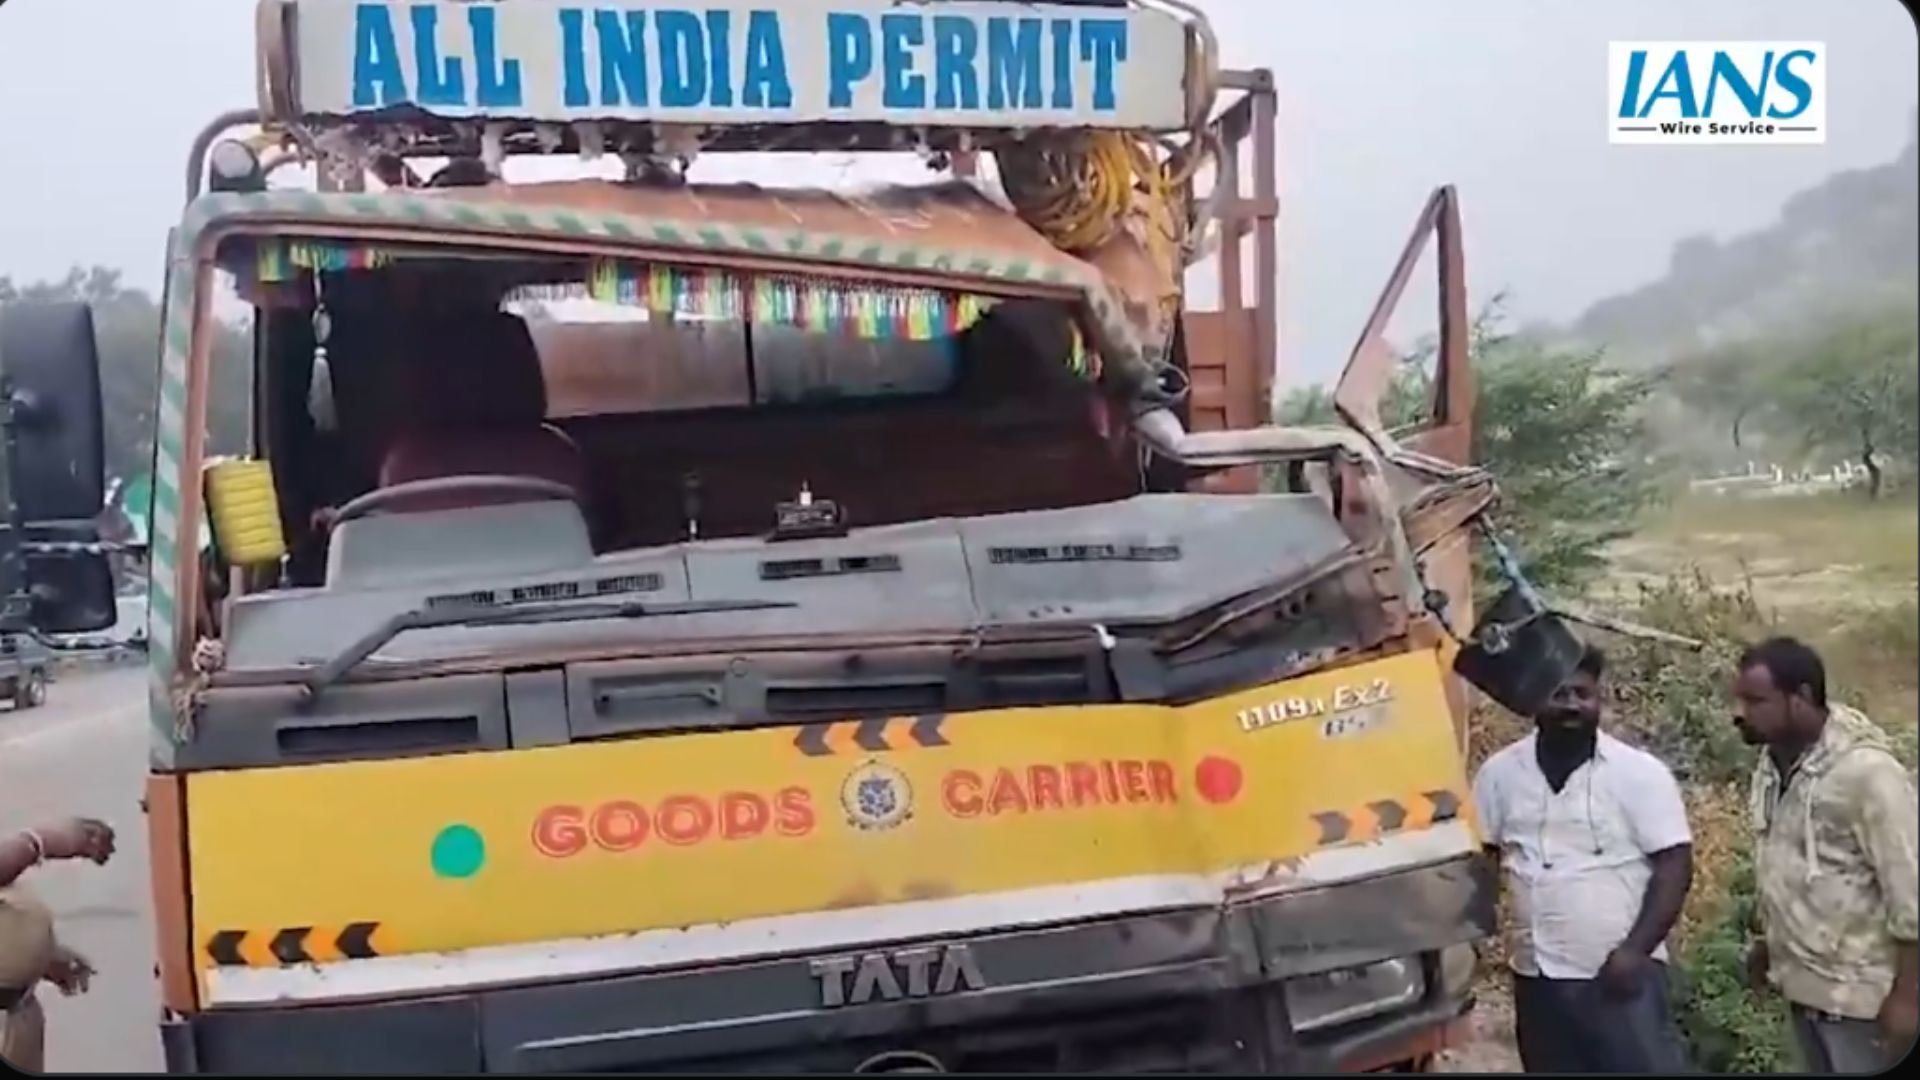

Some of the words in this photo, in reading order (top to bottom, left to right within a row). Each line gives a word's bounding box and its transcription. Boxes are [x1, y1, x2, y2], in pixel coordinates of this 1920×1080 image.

[353, 4, 522, 107] ALL
[559, 9, 792, 107] INDIA
[827, 13, 1127, 110] PERMIT
[531, 786, 815, 858] GOODS
[942, 760, 1178, 818] CARRIER
[809, 944, 985, 1006] TATA
